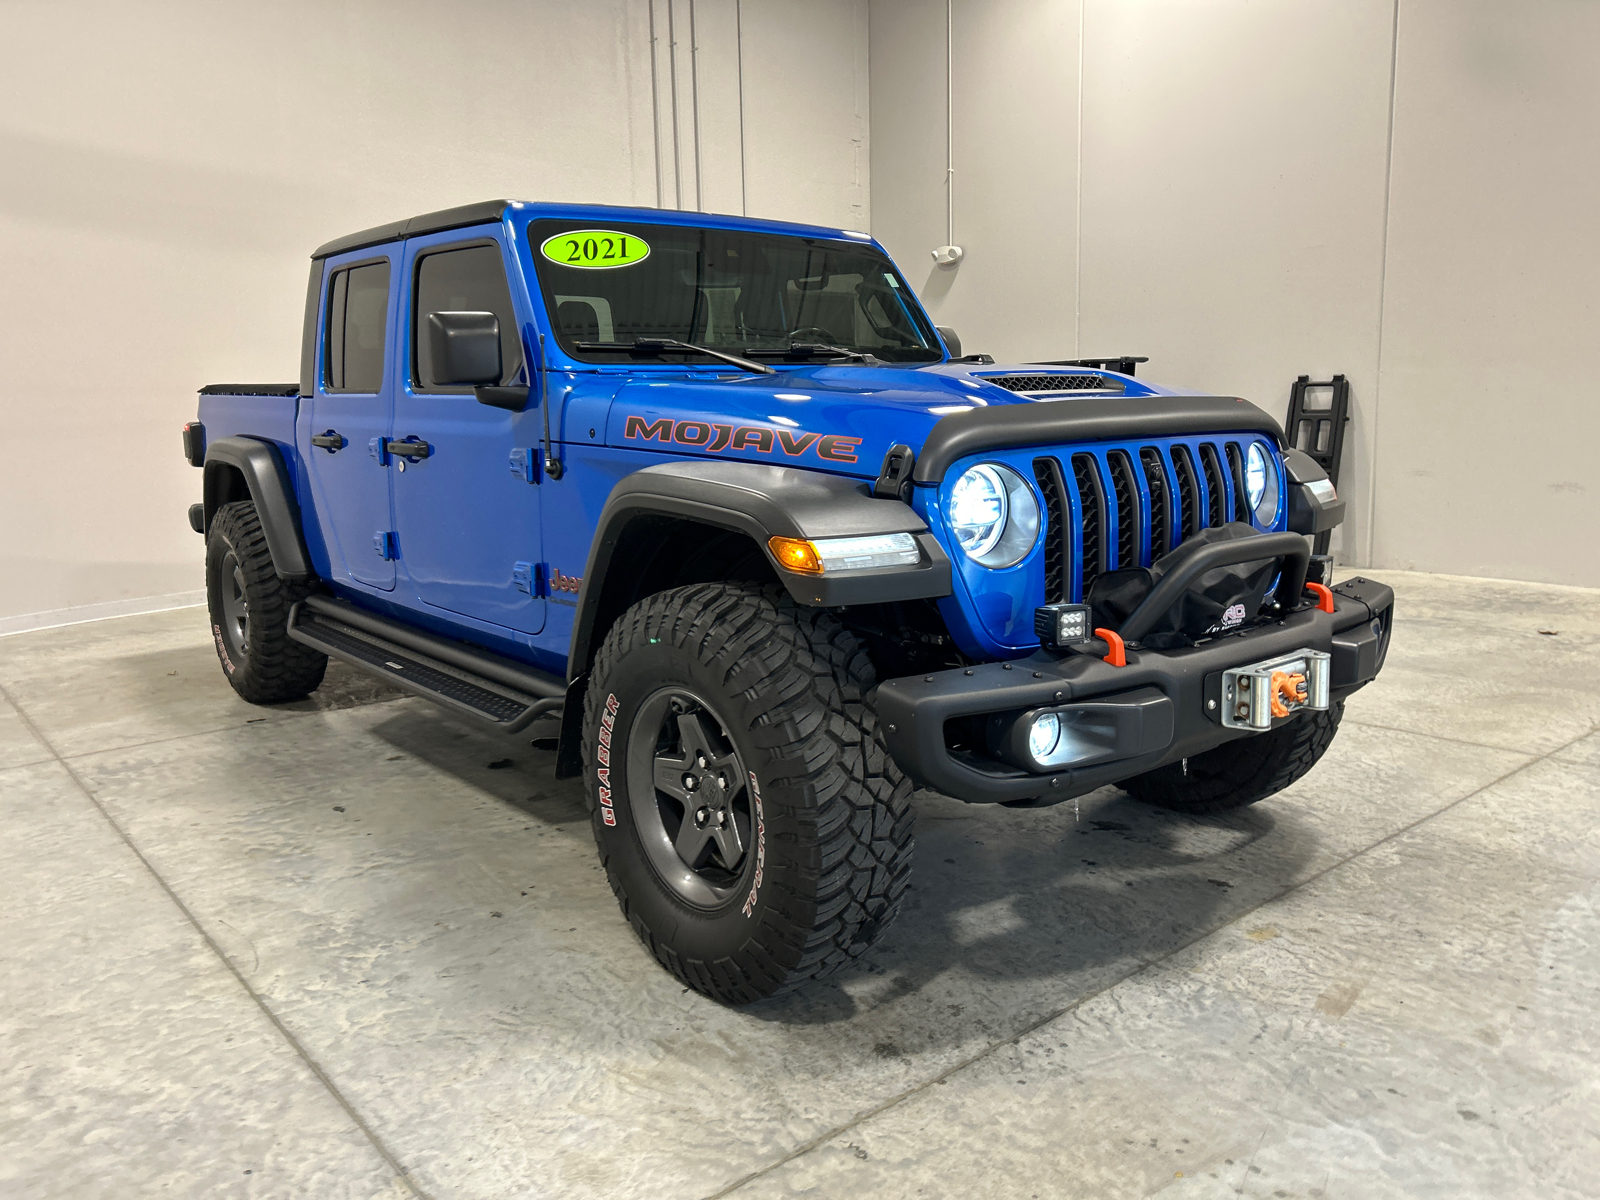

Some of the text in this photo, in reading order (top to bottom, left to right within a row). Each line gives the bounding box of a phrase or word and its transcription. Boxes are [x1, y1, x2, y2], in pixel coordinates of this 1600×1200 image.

[566, 237, 630, 262] 2021
[624, 415, 863, 463] MOJAVE
[597, 693, 621, 826] GRABBER
[741, 770, 766, 919] GENERAL
